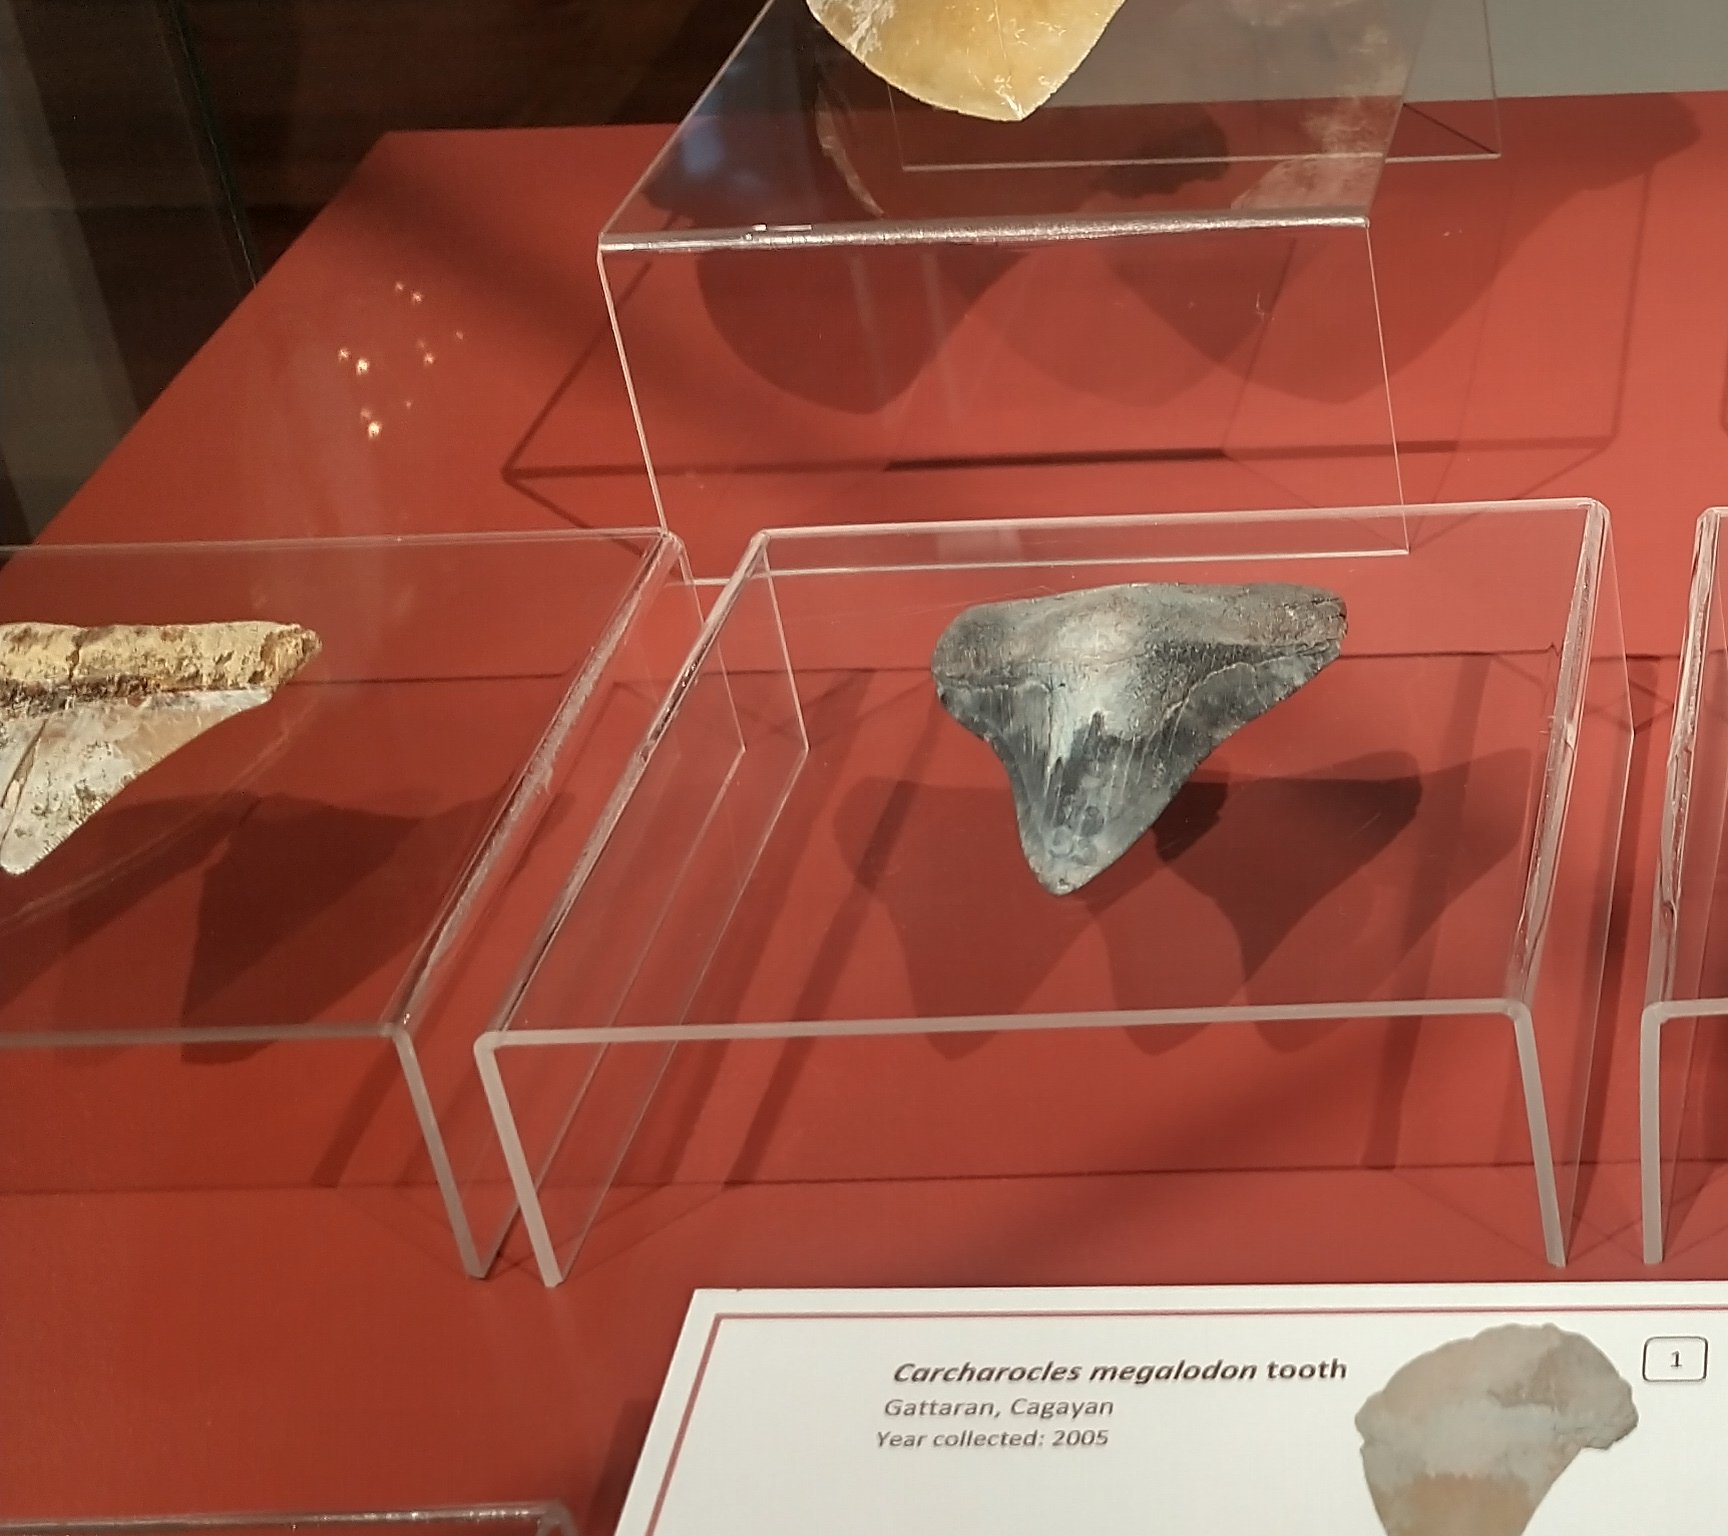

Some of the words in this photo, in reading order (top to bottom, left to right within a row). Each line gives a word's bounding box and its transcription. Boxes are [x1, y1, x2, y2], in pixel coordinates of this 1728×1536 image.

[893, 1360, 1083, 1384] Carcharocles
[1088, 1358, 1258, 1386] megalodon
[1267, 1357, 1347, 1381] tooth
[1670, 1349, 1683, 1371] 1
[883, 1398, 1001, 1420] Gattaran,
[1009, 1397, 1114, 1422] Cagayan
[877, 1430, 928, 1449] Year
[932, 1428, 1045, 1448] collected:
[1051, 1428, 1109, 1448] 2005
